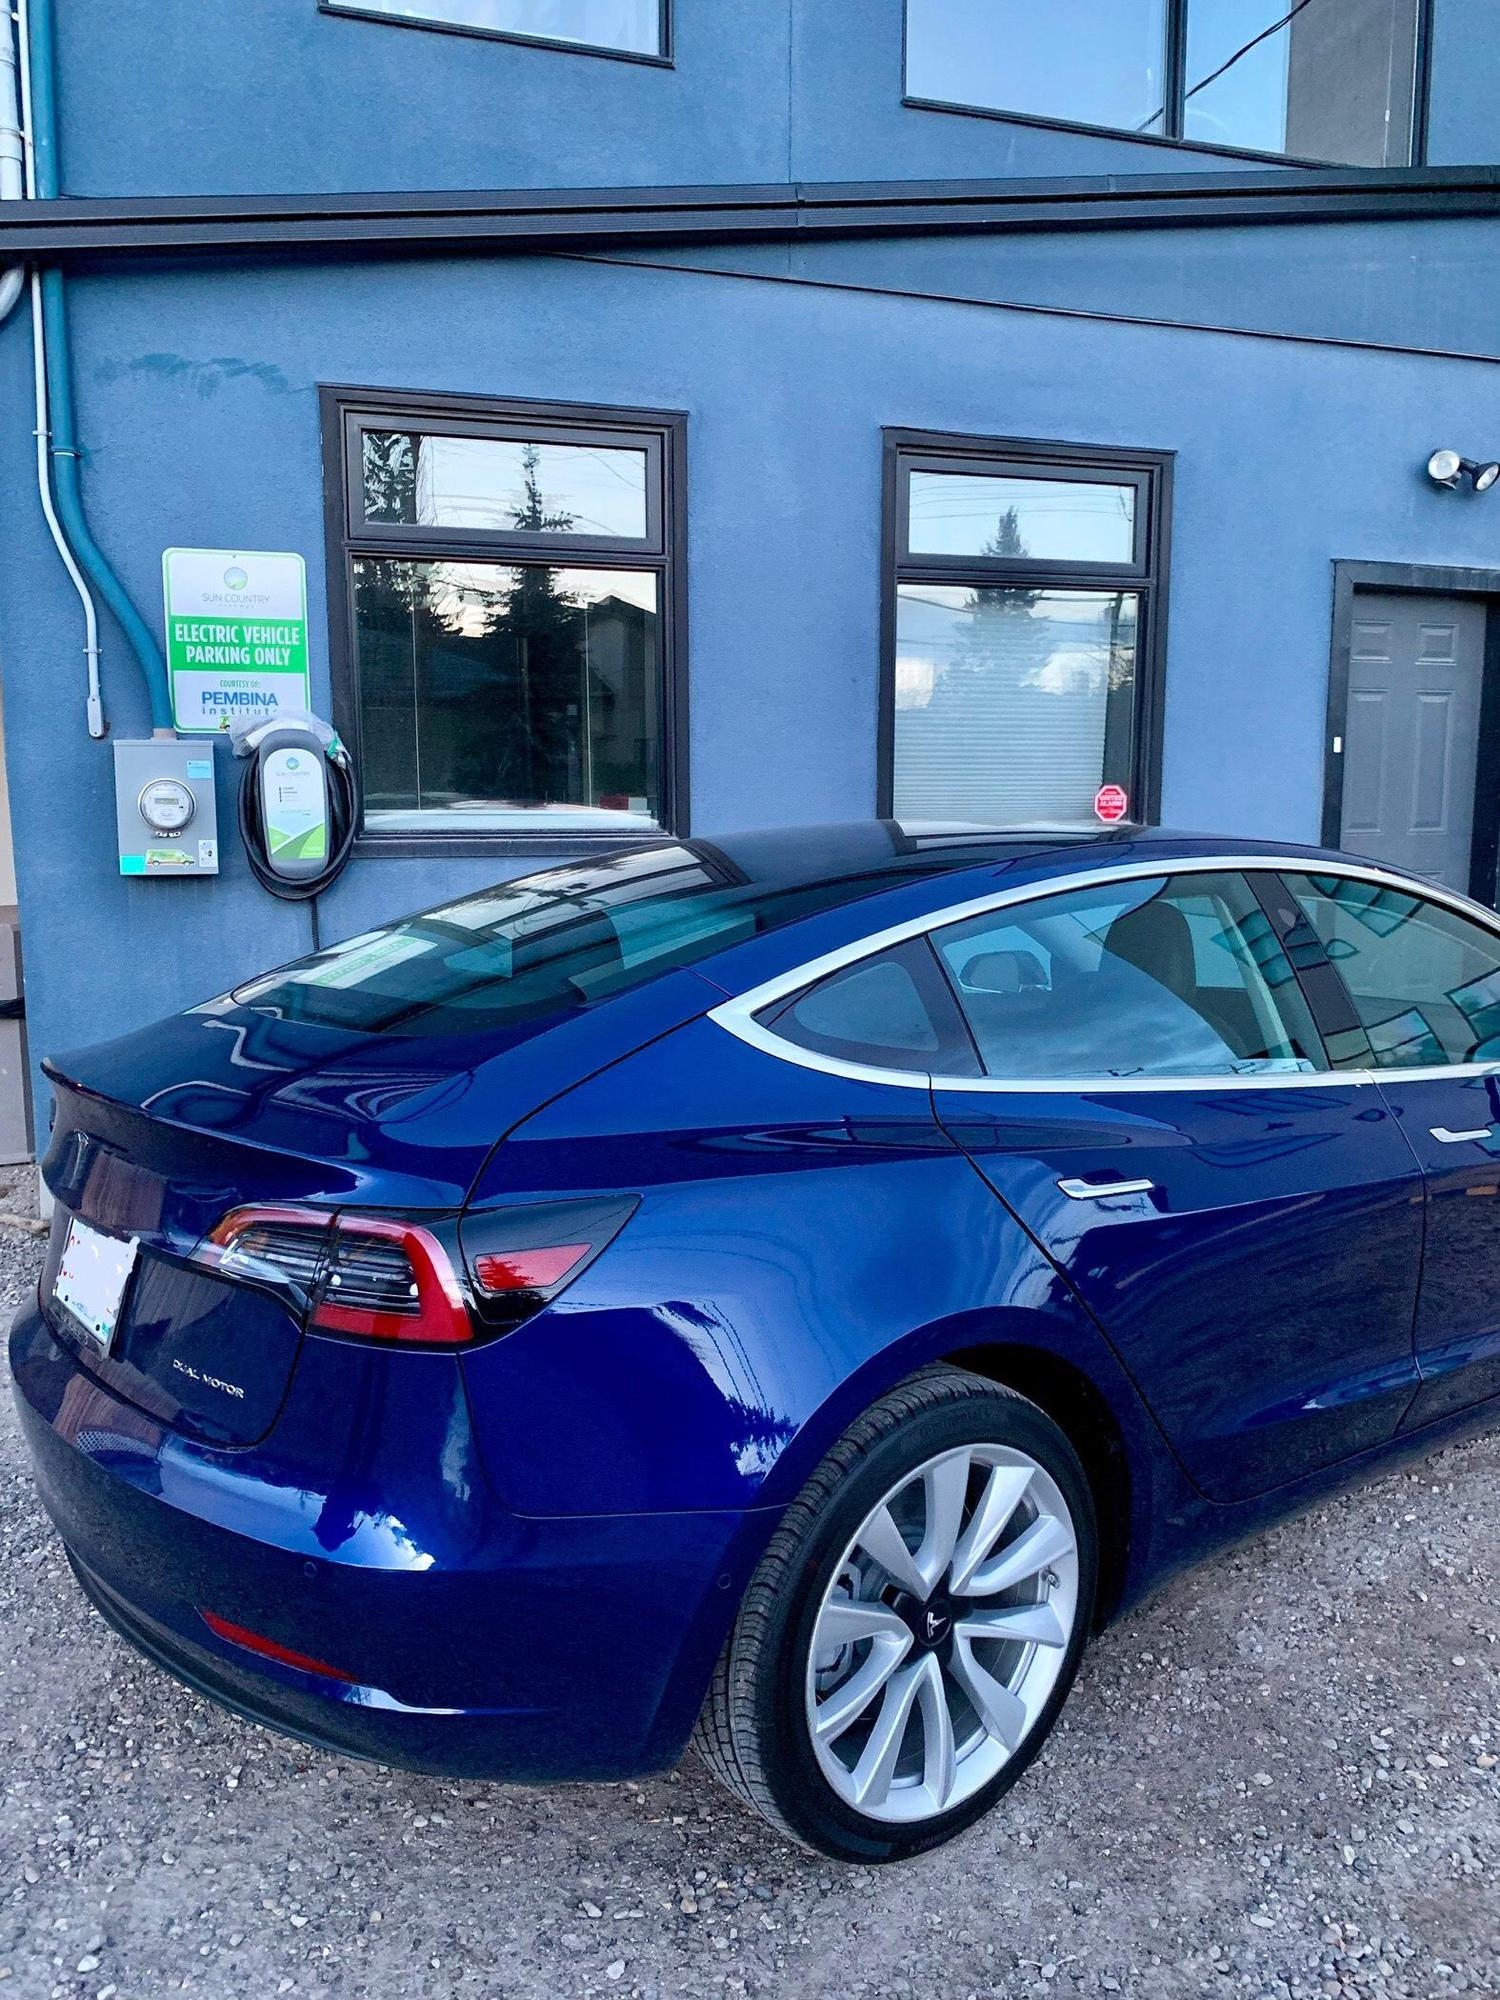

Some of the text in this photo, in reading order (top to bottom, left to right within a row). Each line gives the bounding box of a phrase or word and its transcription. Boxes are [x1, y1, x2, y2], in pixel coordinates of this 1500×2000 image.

[202, 592, 271, 604] SUN COUNTRY
[174, 623, 300, 645] ELECTRIC VEHICLE
[186, 645, 291, 666] PARKING ONLY
[220, 679, 249, 688] COURTESY
[201, 691, 279, 706] PEMBINA
[202, 1373, 244, 1399] MOTOR
